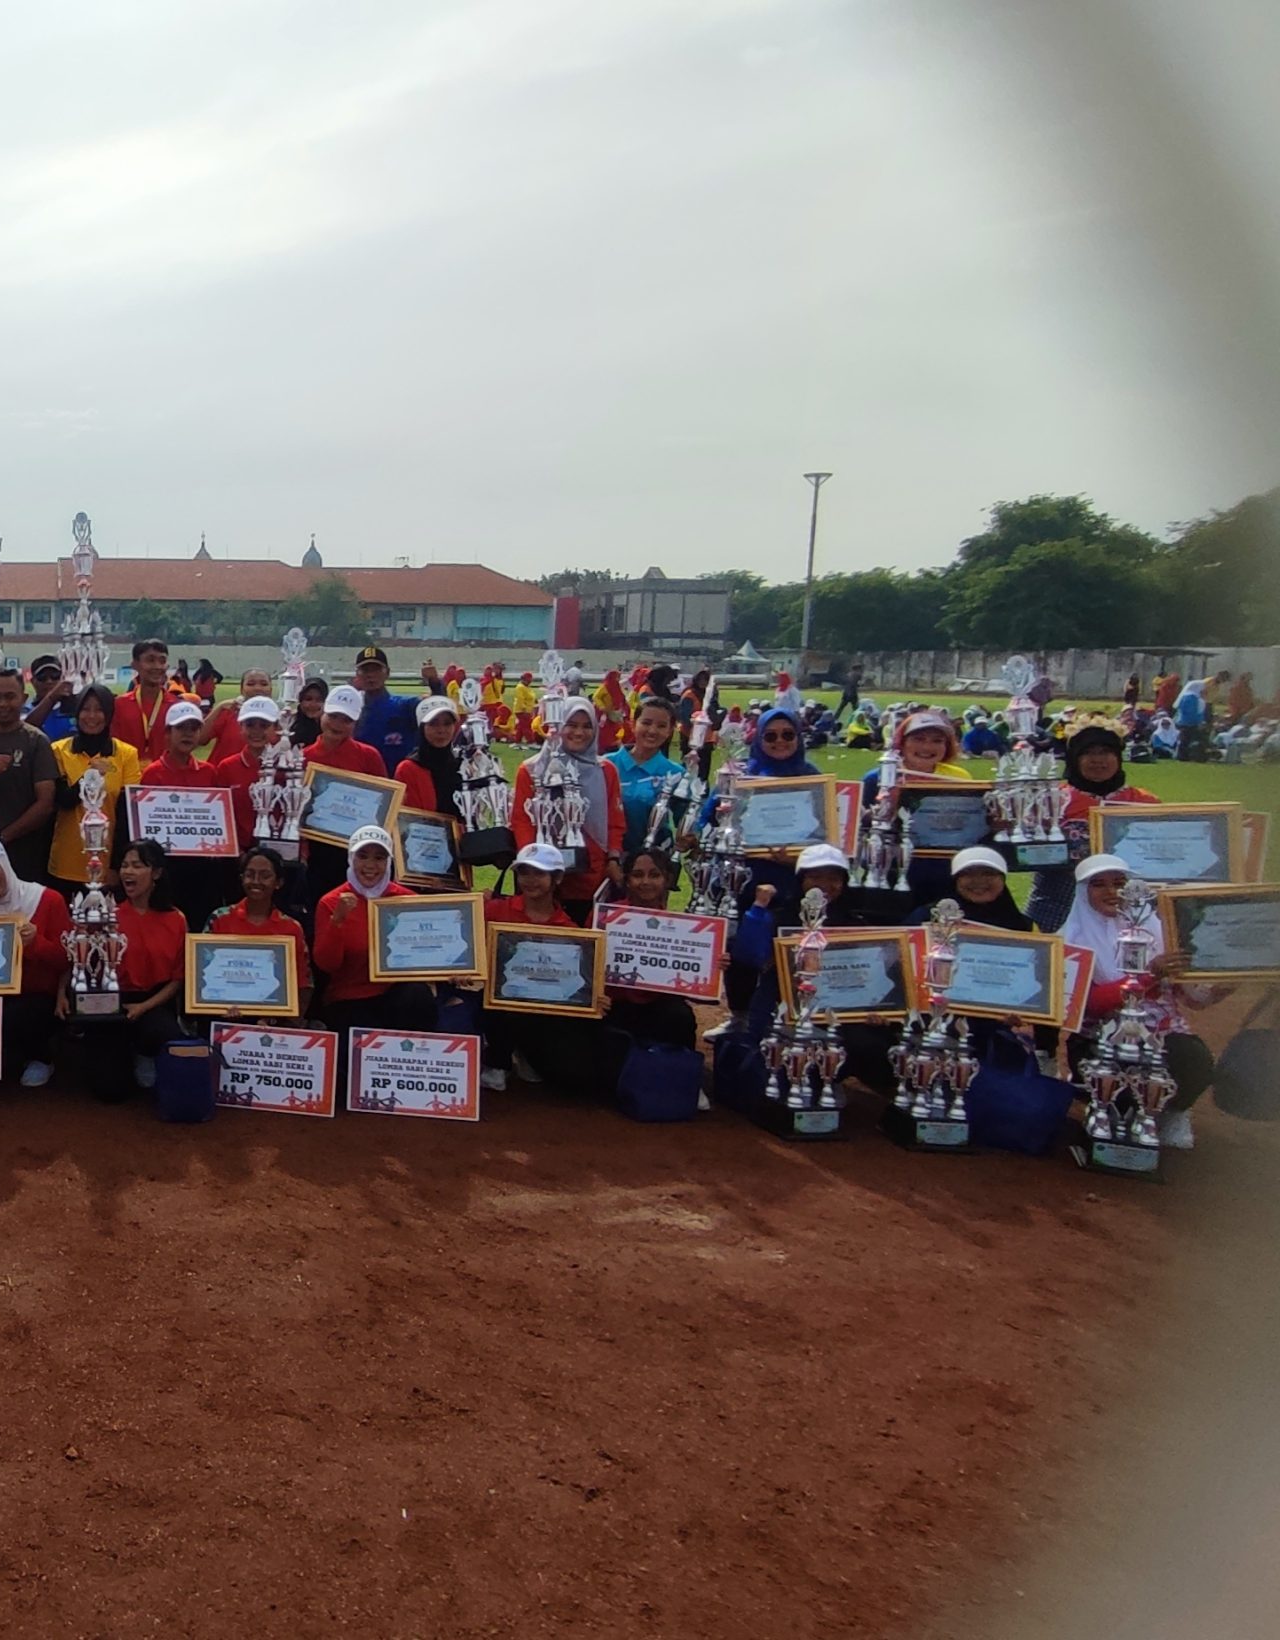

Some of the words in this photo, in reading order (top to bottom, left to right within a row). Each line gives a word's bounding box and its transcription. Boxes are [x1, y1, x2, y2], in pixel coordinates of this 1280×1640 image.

[144, 825, 161, 835] RP
[166, 826, 223, 836] 1.000.000
[622, 939, 648, 948] LOMBA
[614, 952, 634, 963] RP
[640, 956, 700, 973] 500.000
[238, 1050, 265, 1059] JUARA
[232, 1058, 260, 1066] LOMBA
[365, 1055, 389, 1063] JUARA
[391, 1057, 428, 1065] HARAPAN
[378, 1063, 404, 1071] LOMBA
[230, 1072, 251, 1084] RP
[255, 1075, 313, 1090] 750.000
[371, 1077, 391, 1089] RP
[397, 1079, 457, 1094] 600.000
